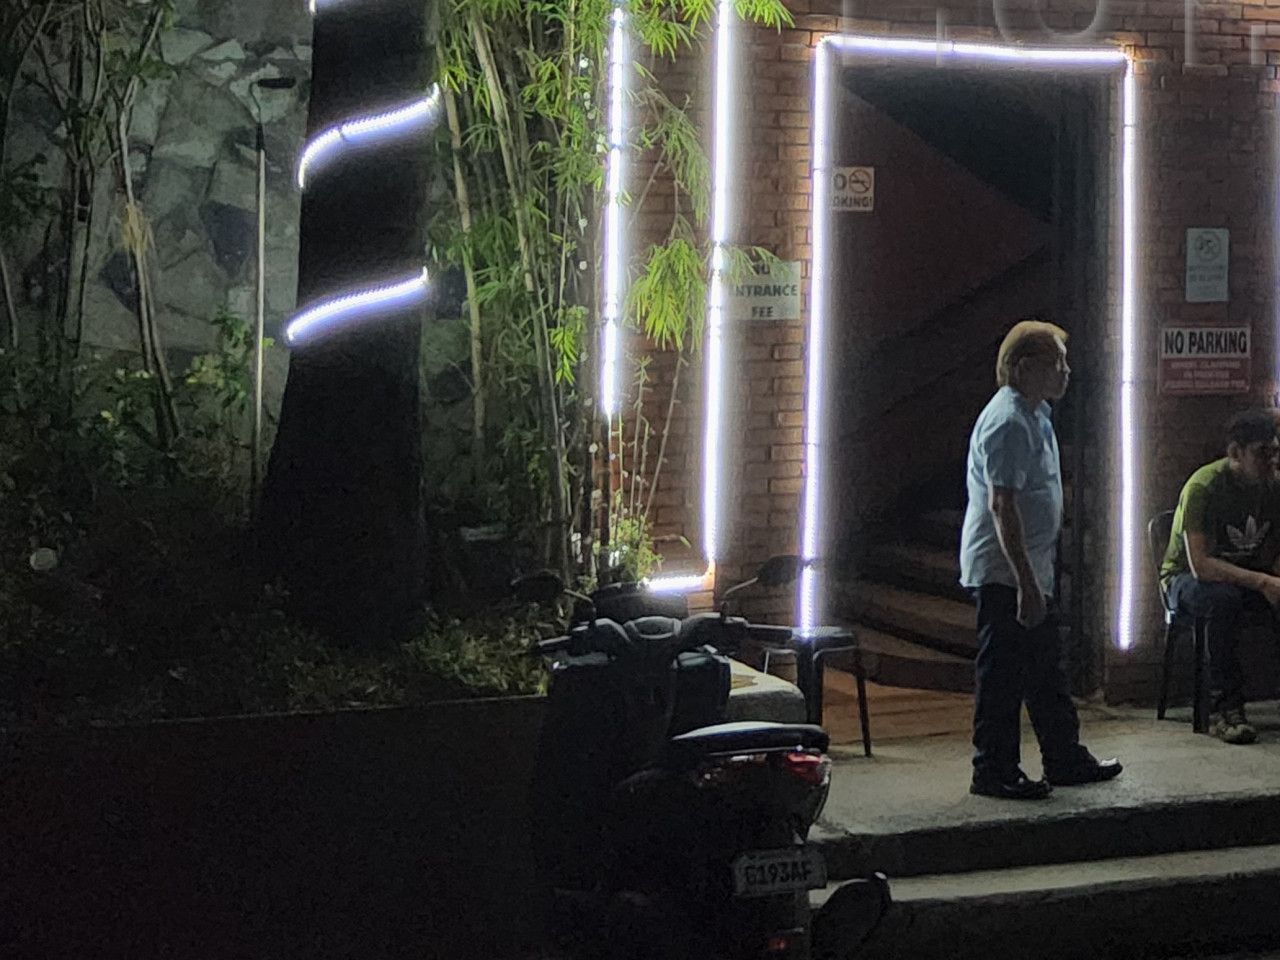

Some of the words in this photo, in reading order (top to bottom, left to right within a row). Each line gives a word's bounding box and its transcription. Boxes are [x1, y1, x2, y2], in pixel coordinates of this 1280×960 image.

[752, 306, 774, 317] FEE
[1165, 330, 1184, 354] NO
[1189, 330, 1247, 354] PARKING
